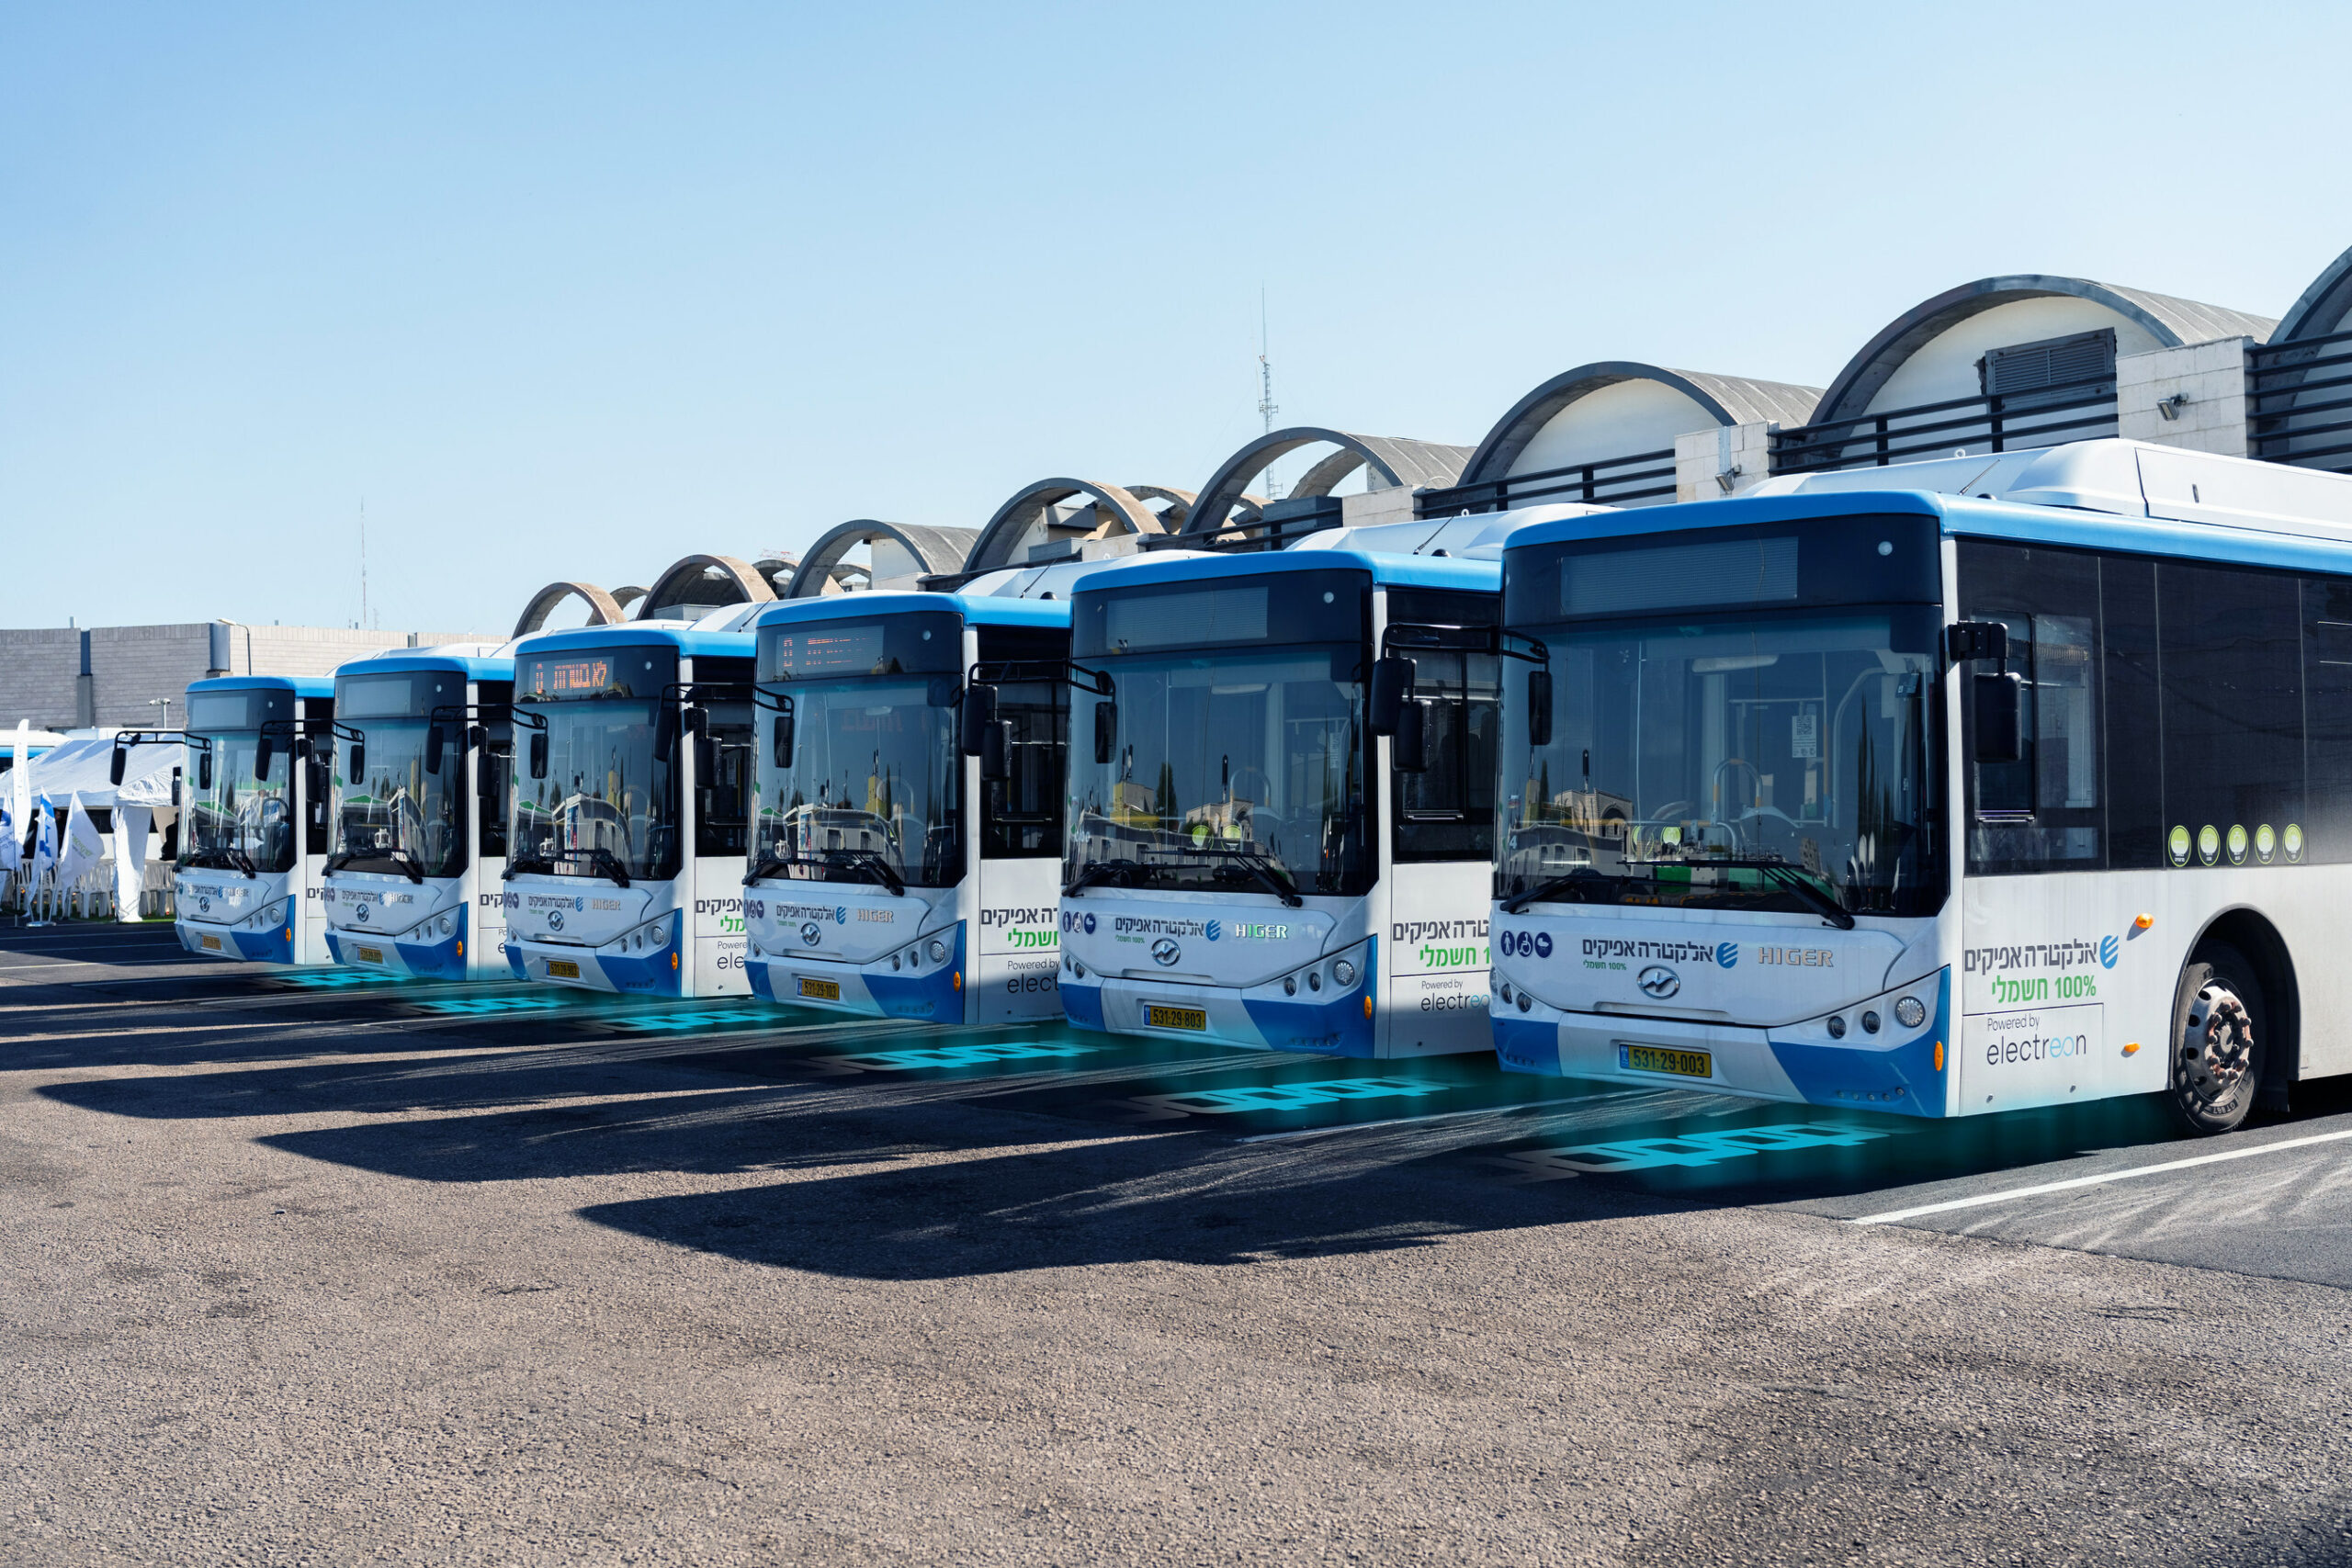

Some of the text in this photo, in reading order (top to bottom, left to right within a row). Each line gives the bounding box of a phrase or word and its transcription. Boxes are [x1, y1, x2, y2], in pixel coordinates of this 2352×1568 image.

[857, 908, 895, 923] HIGER
[980, 907, 1038, 928] אפיקים
[1114, 917, 1204, 938] אלקטרה אפיקים
[1235, 923, 1289, 939] HIGER
[1392, 920, 1451, 944] אפיקים
[717, 940, 748, 950] Powere
[1419, 943, 1476, 968] חשמלי
[1582, 939, 1713, 964] אלקטרה אפיקים
[1007, 958, 1060, 971] Powered by
[1758, 946, 1835, 967] HIGER
[1964, 938, 2098, 976] אלקטרה אפיקים
[1006, 972, 1058, 994] elect
[1421, 978, 1464, 990] Powered by
[1992, 975, 2097, 1004] 100% חשמלי
[1420, 992, 1489, 1011] electreo
[1986, 1013, 2040, 1032] Powered by
[1986, 1033, 2086, 1066] electreon
